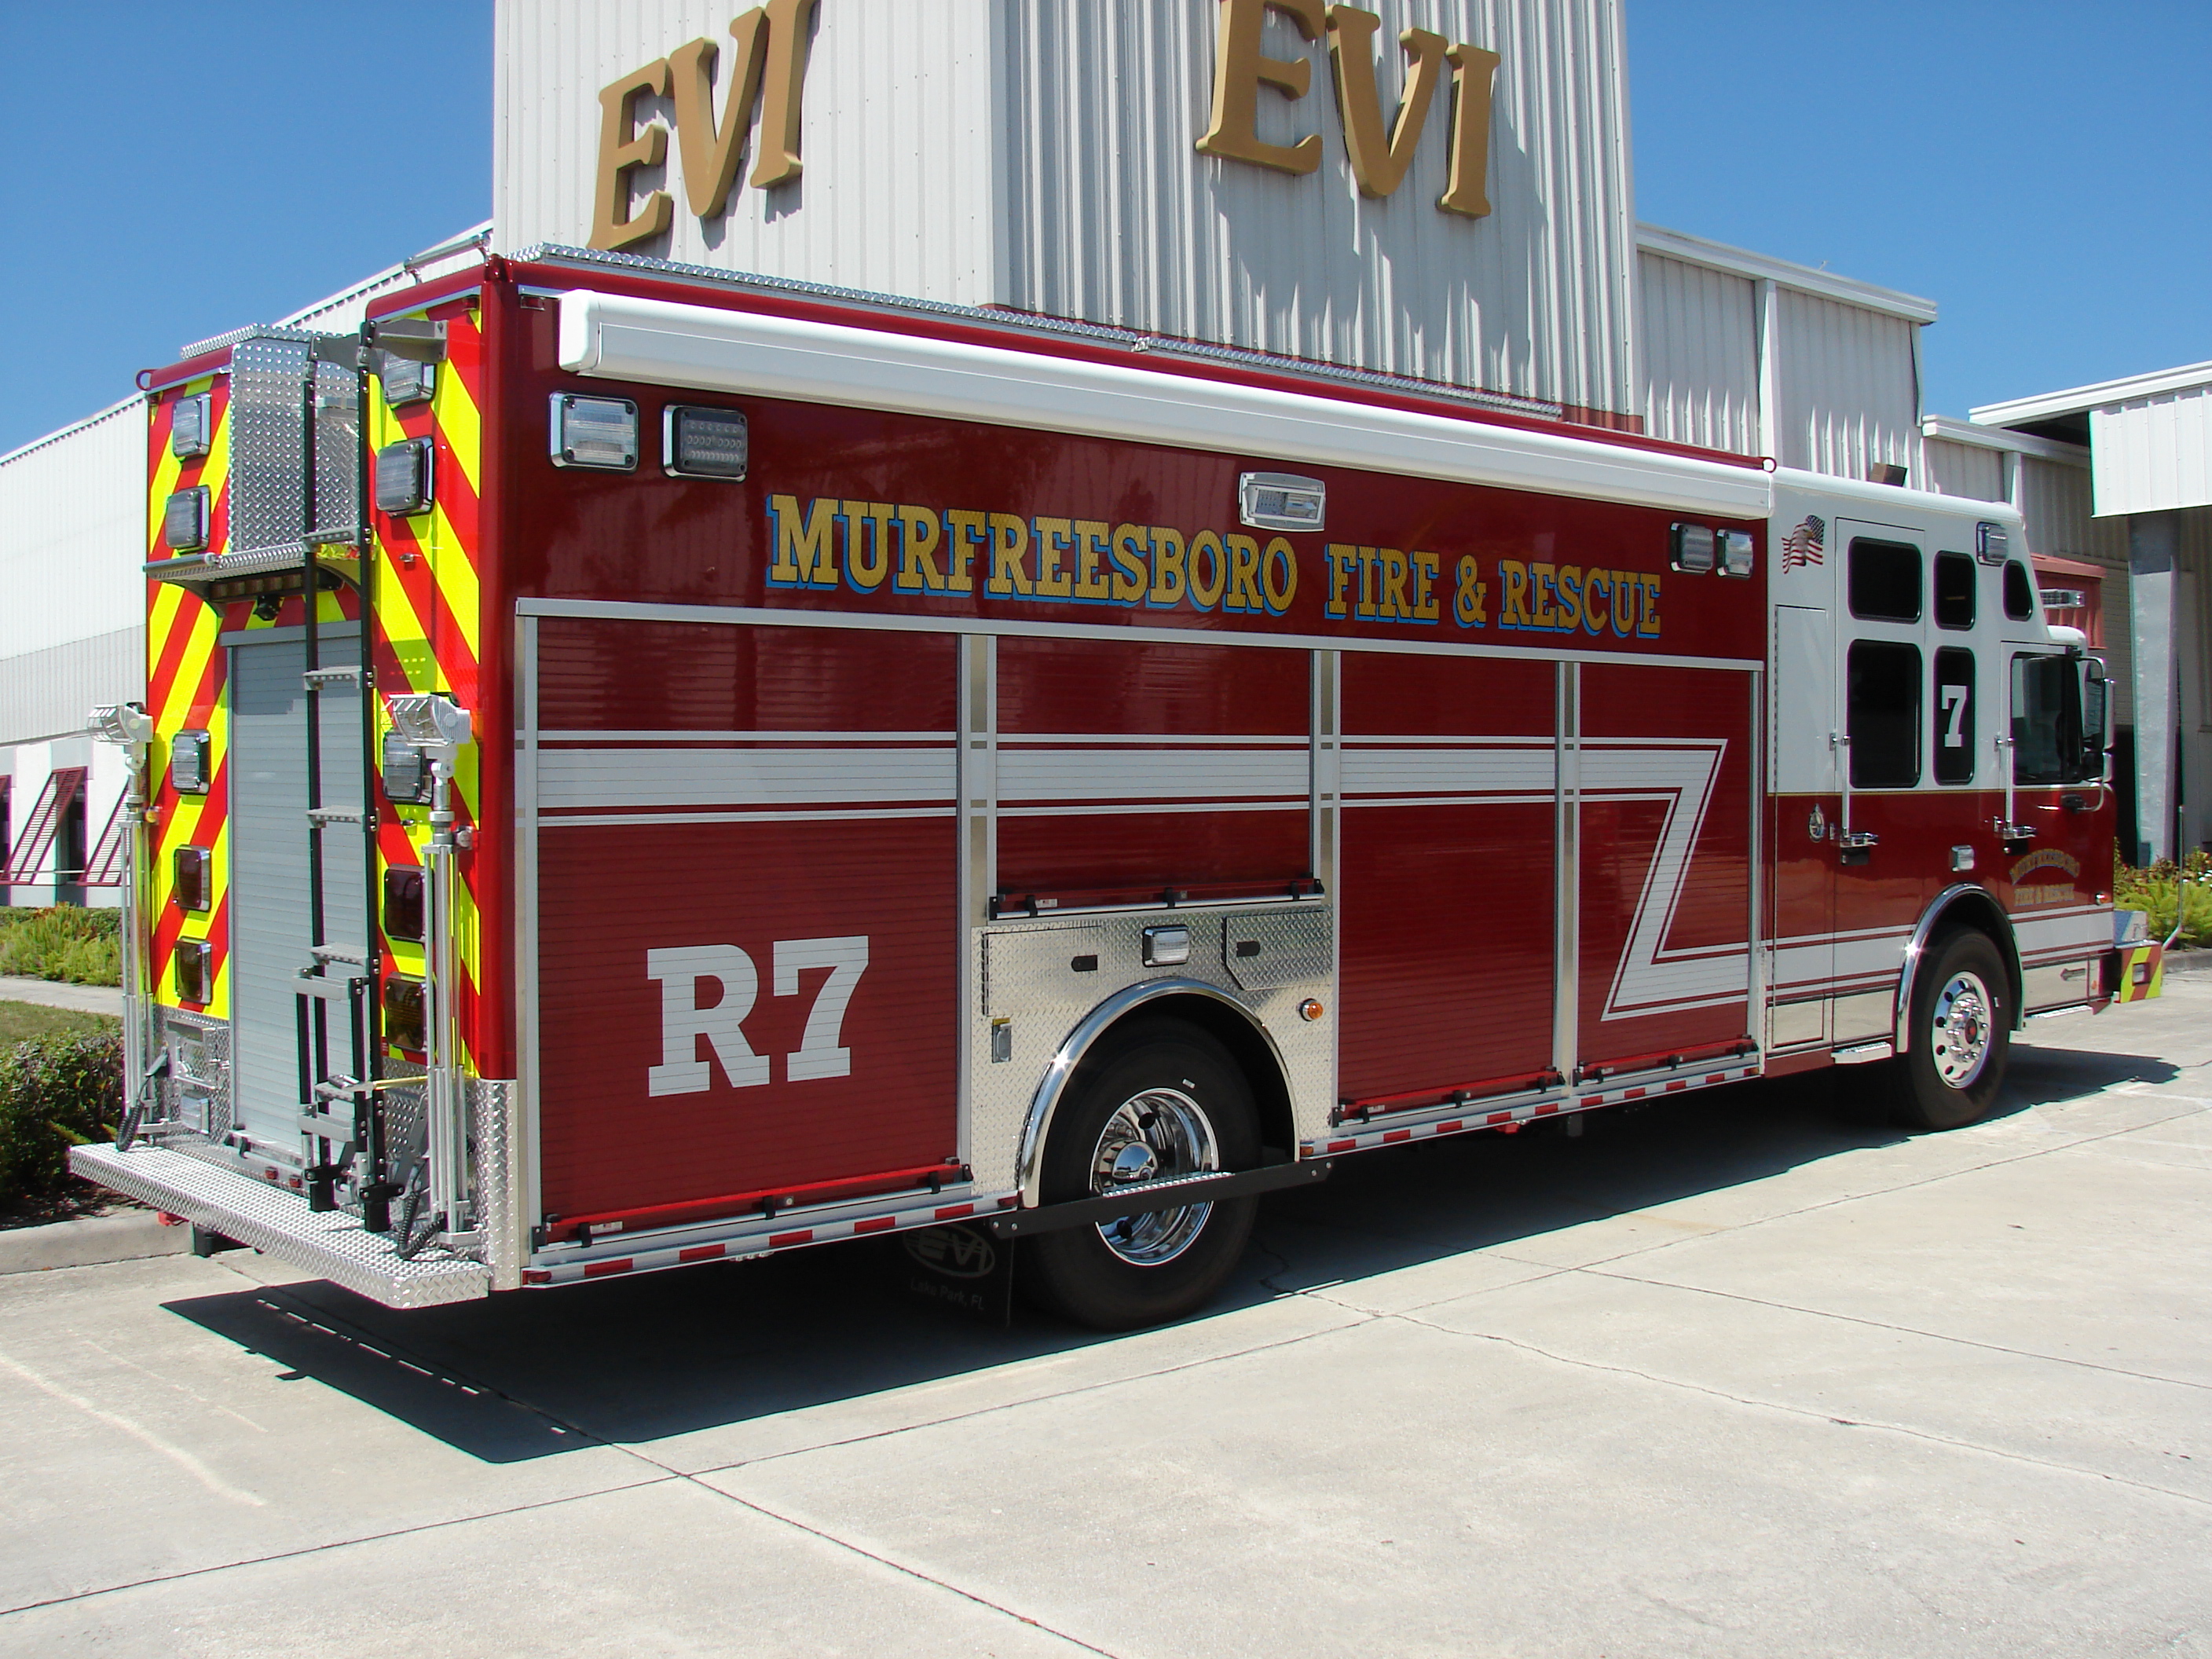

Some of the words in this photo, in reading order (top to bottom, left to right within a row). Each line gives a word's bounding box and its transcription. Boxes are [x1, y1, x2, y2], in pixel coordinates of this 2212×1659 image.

[586, 0, 814, 250] EVI
[1195, 0, 1501, 220] EVI
[766, 493, 1298, 617] MURFREESBORO
[1324, 543, 1441, 626] FIRE
[1453, 554, 1487, 629] &
[1498, 558, 1661, 639] RESCUE
[1941, 684, 1968, 749] 7
[646, 935, 870, 1097] R7
[971, 1293, 984, 1311] FL
